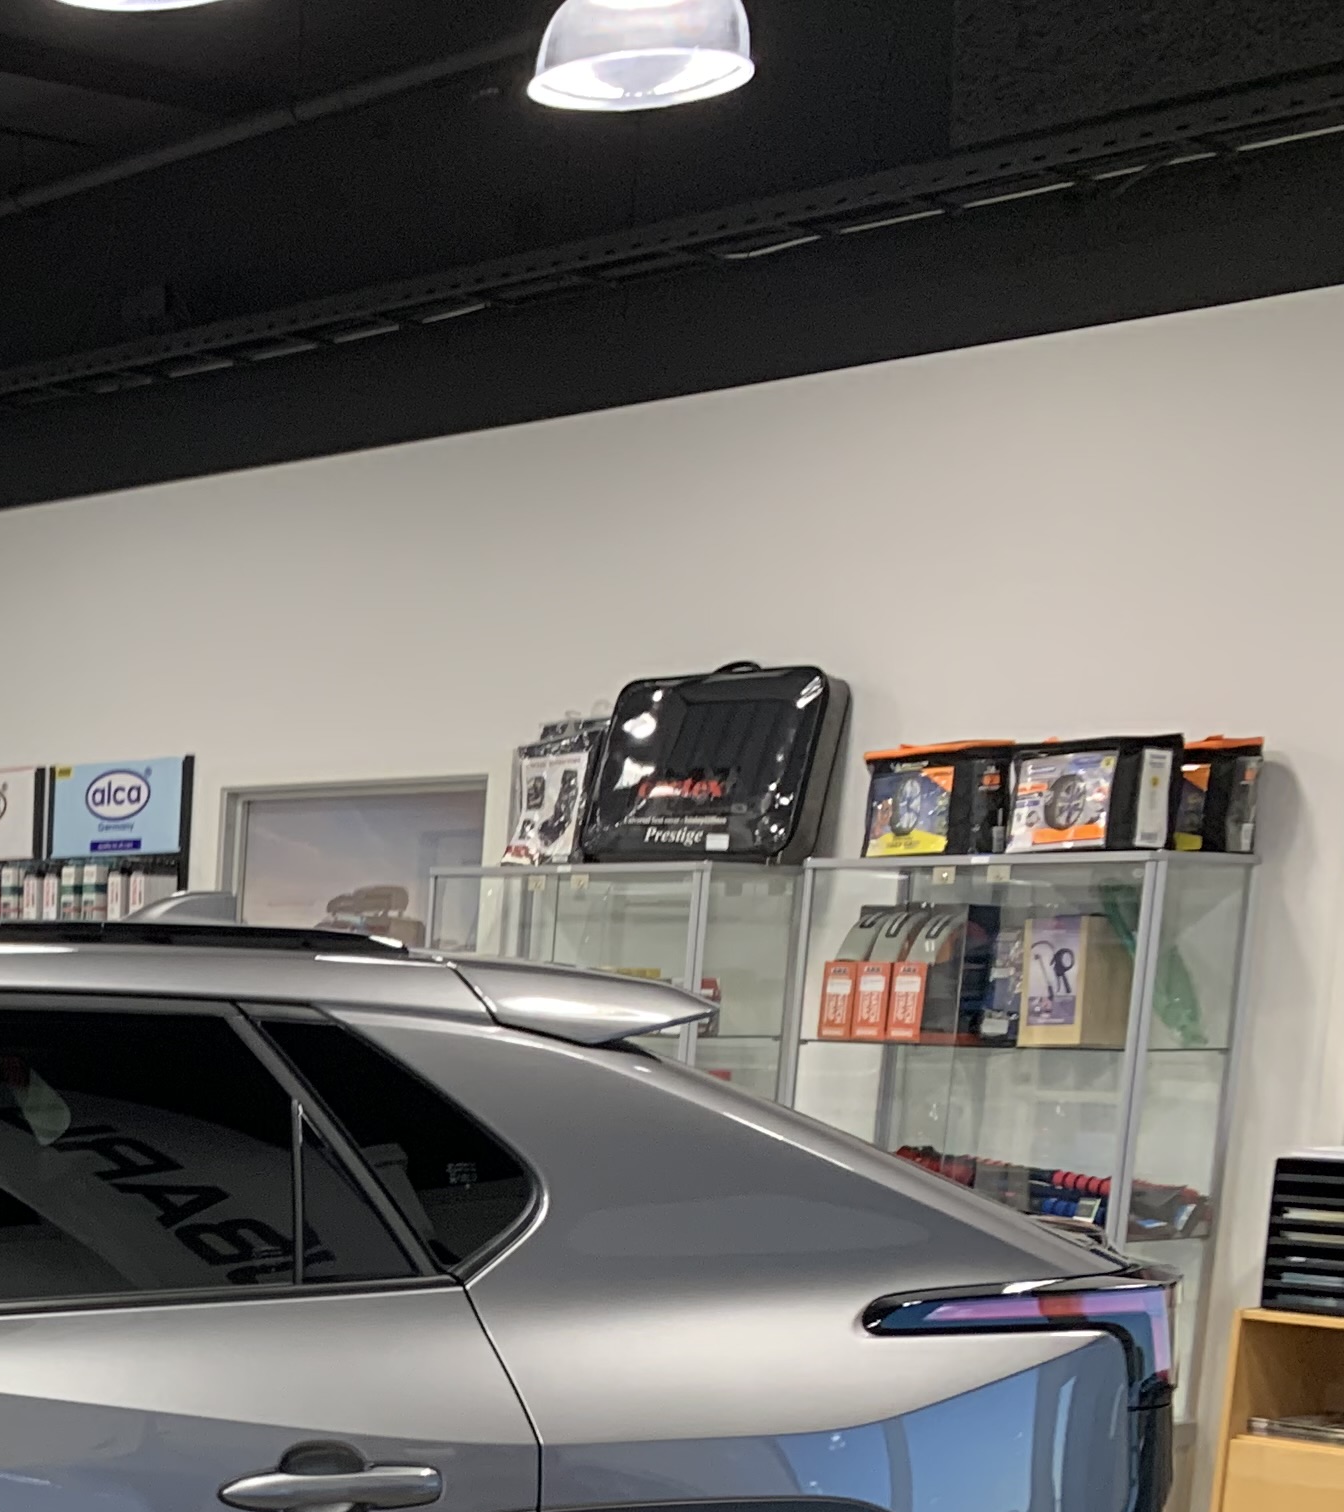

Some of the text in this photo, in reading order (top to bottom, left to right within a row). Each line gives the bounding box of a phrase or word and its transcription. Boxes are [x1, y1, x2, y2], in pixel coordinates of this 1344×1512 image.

[90, 780, 142, 807] alca
[98, 821, 135, 833] Germany
[643, 825, 705, 848] Prestige
